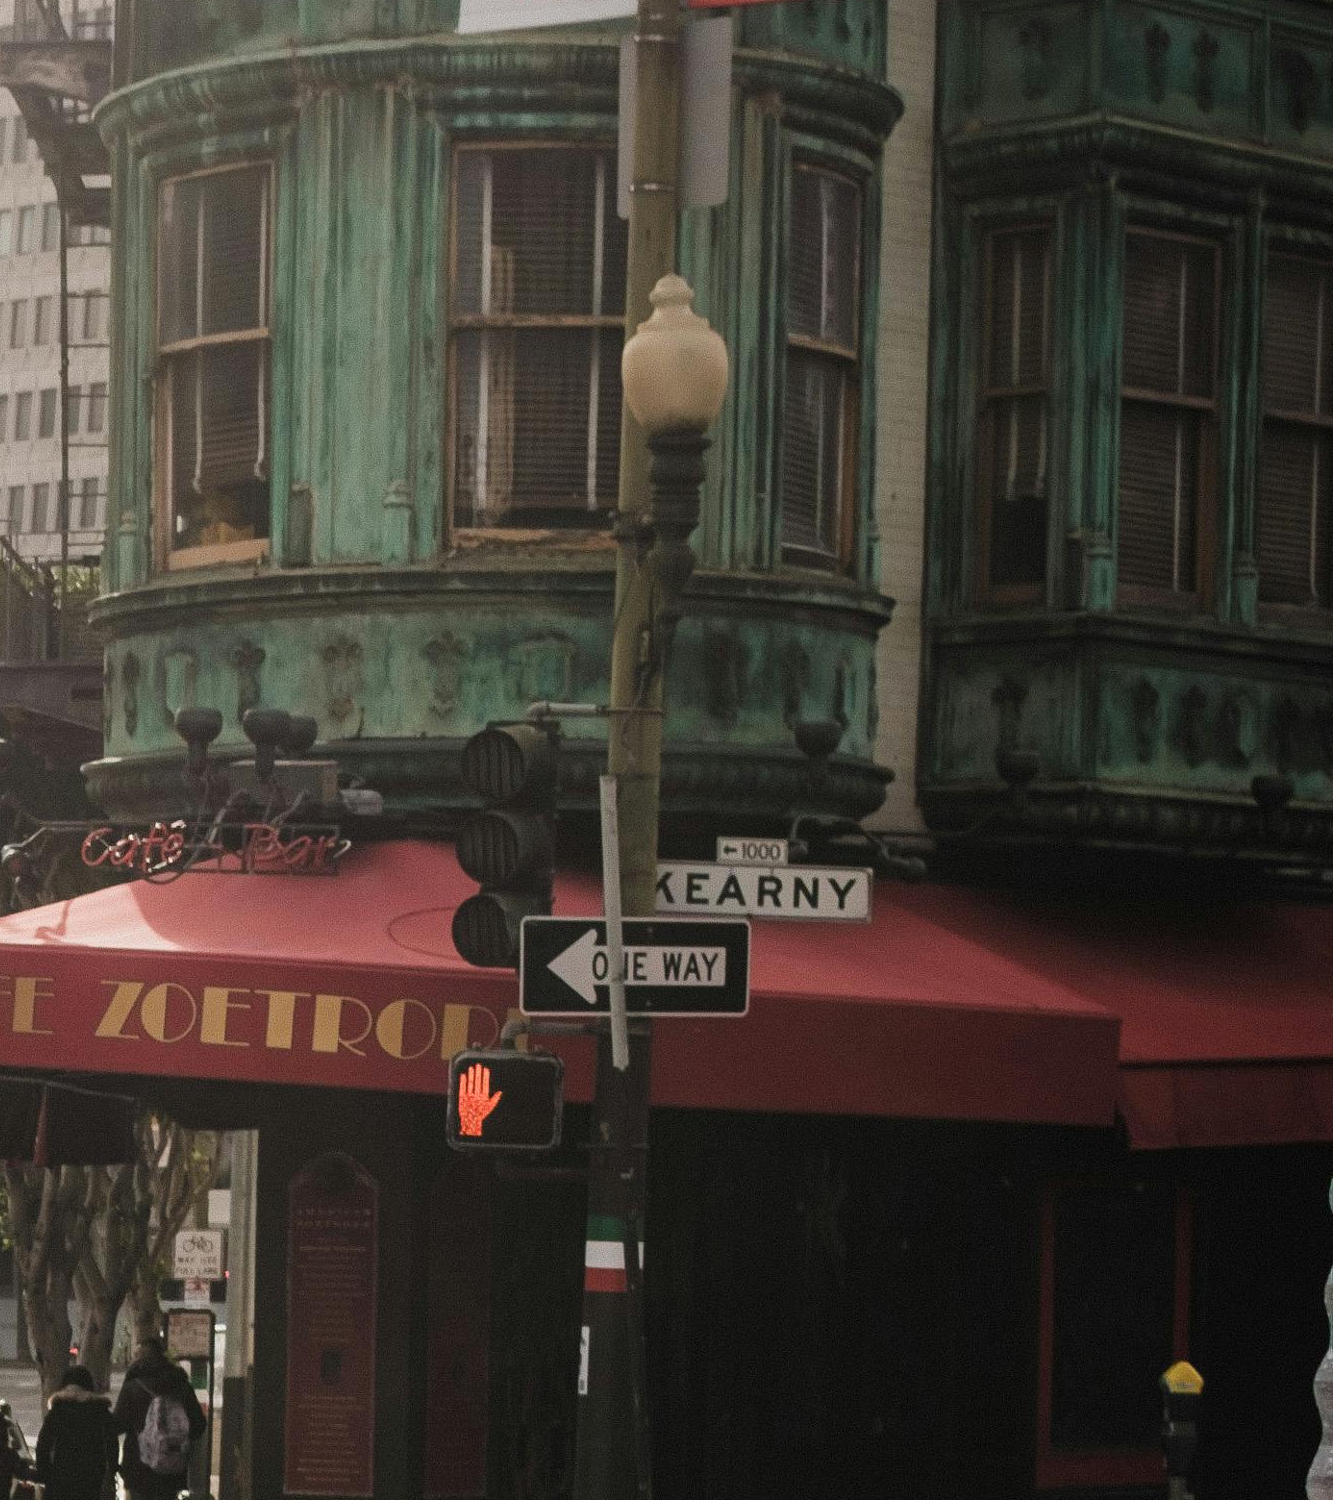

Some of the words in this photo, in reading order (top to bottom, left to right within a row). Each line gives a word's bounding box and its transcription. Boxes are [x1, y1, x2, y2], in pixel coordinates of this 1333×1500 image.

[741, 843, 781, 862] 1000
[656, 872, 857, 910] KEARNY
[663, 952, 719, 982] WAY
